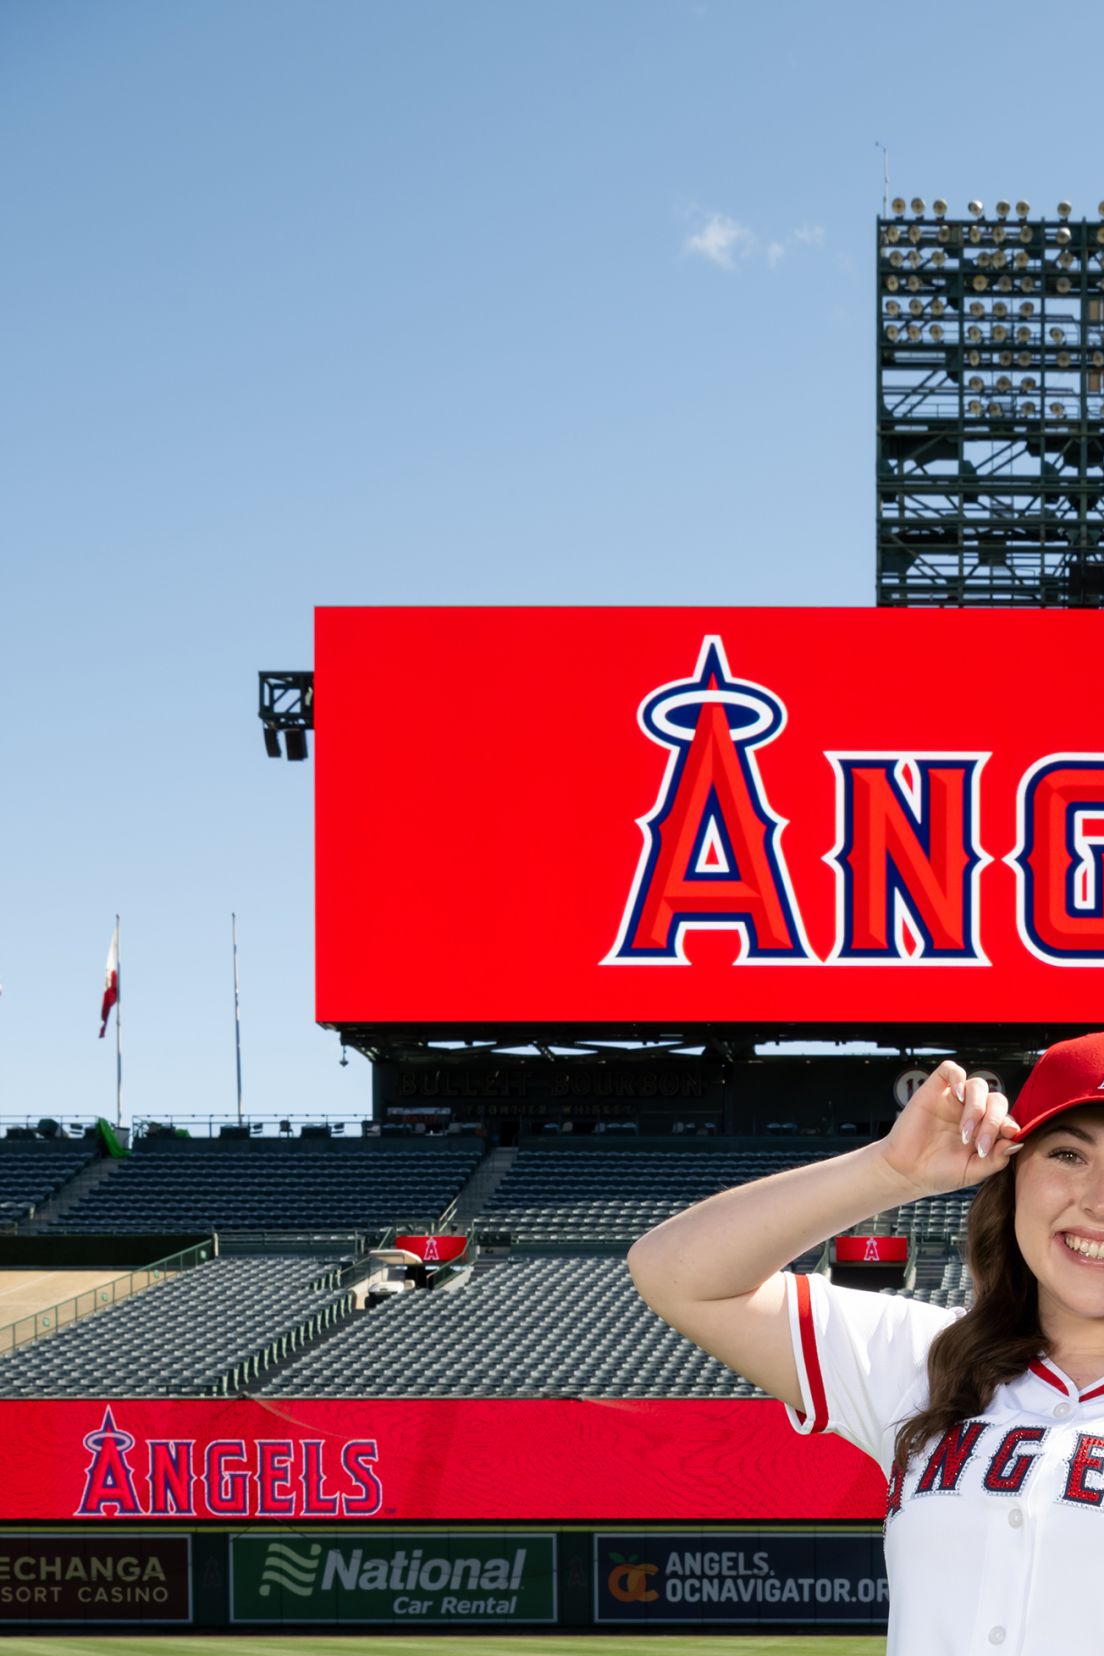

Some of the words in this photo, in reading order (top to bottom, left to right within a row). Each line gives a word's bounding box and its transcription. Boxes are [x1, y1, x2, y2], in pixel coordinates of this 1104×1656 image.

[399, 1072, 530, 1097] BULLEIT
[551, 1072, 703, 1097] BOURBON
[423, 1236, 440, 1260] A
[863, 1236, 880, 1261] A
[73, 1404, 383, 1517] ANGELS
[321, 1549, 527, 1591] National
[665, 1551, 776, 1577] ANGELS.
[0, 1586, 63, 1603] SORT
[78, 1586, 169, 1603] CASINO
[393, 1597, 433, 1615] Car
[440, 1596, 517, 1615] Rental
